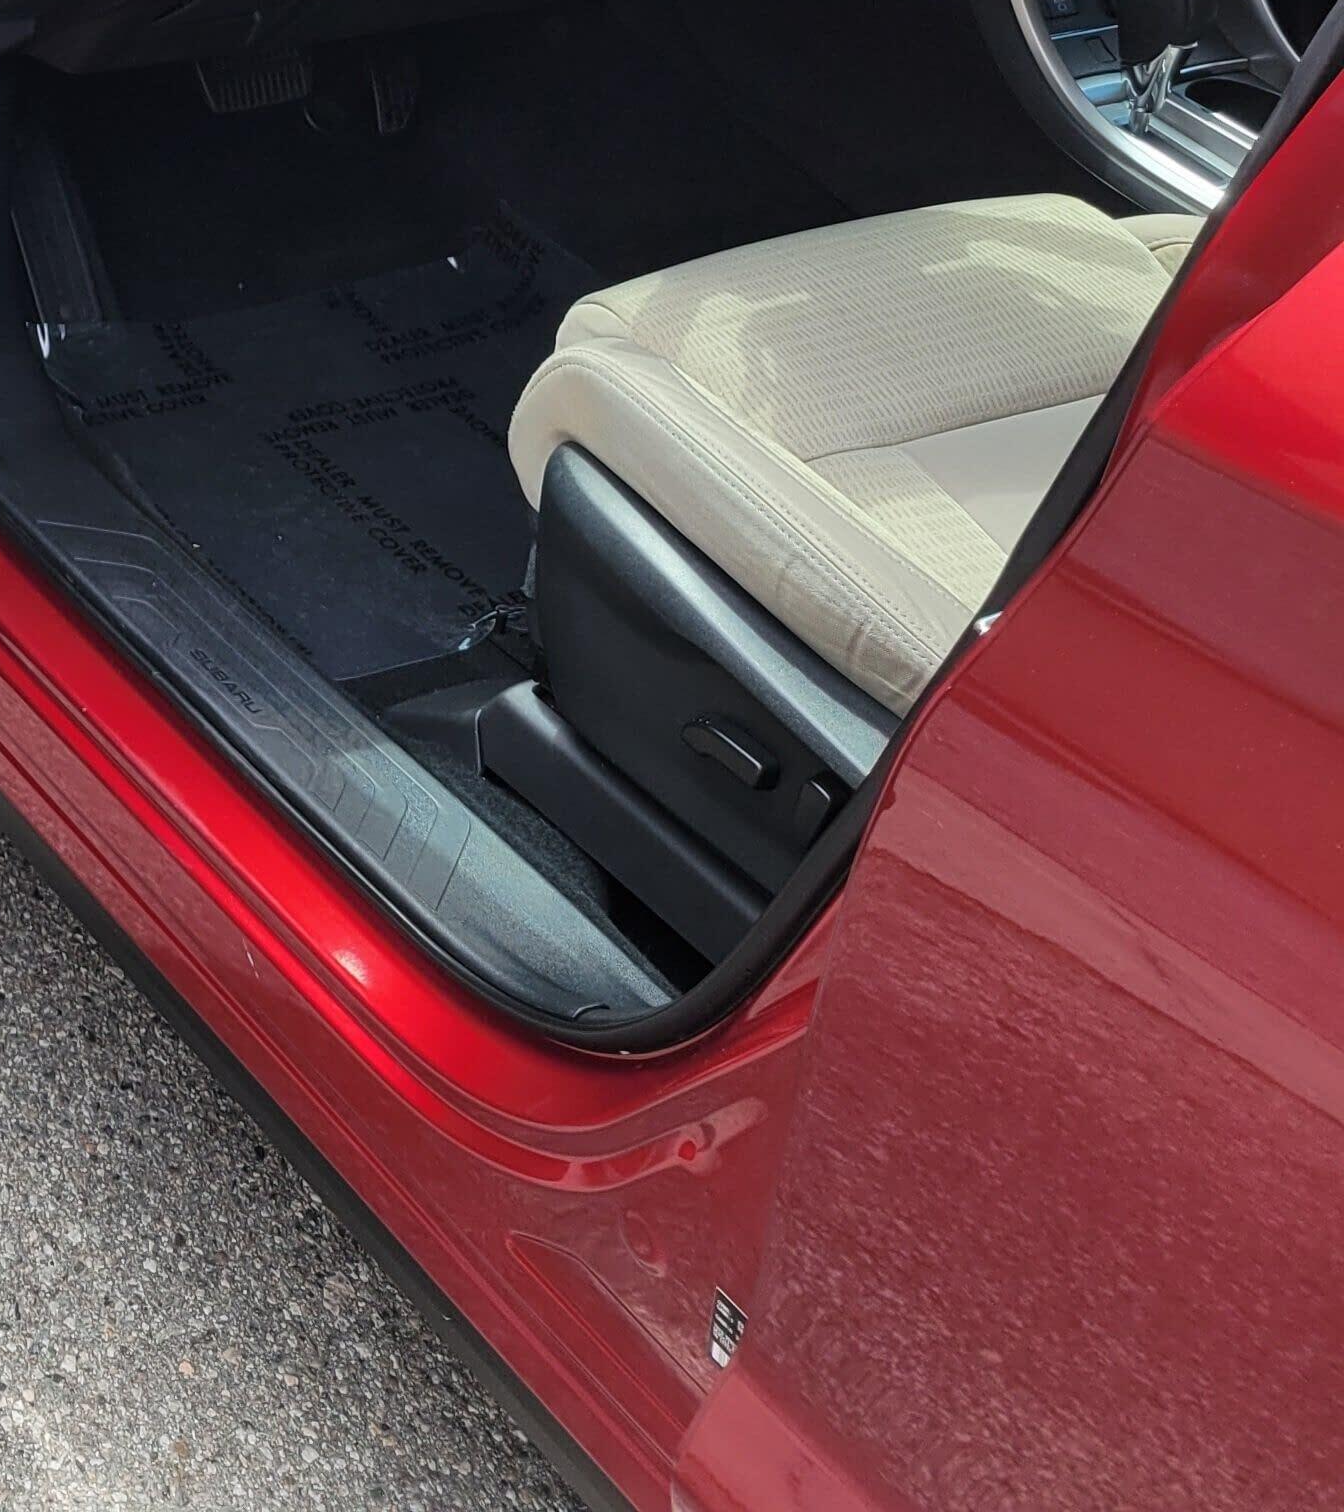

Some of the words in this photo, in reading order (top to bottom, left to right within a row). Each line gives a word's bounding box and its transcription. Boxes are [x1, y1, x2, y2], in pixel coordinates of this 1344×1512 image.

[274, 443, 369, 523] PROTECTIVE
[368, 526, 428, 575] COVER
[294, 439, 357, 487] DEALER
[358, 495, 412, 534] MUST
[409, 538, 488, 597] REMOVE
[189, 648, 261, 714] SUBARU
